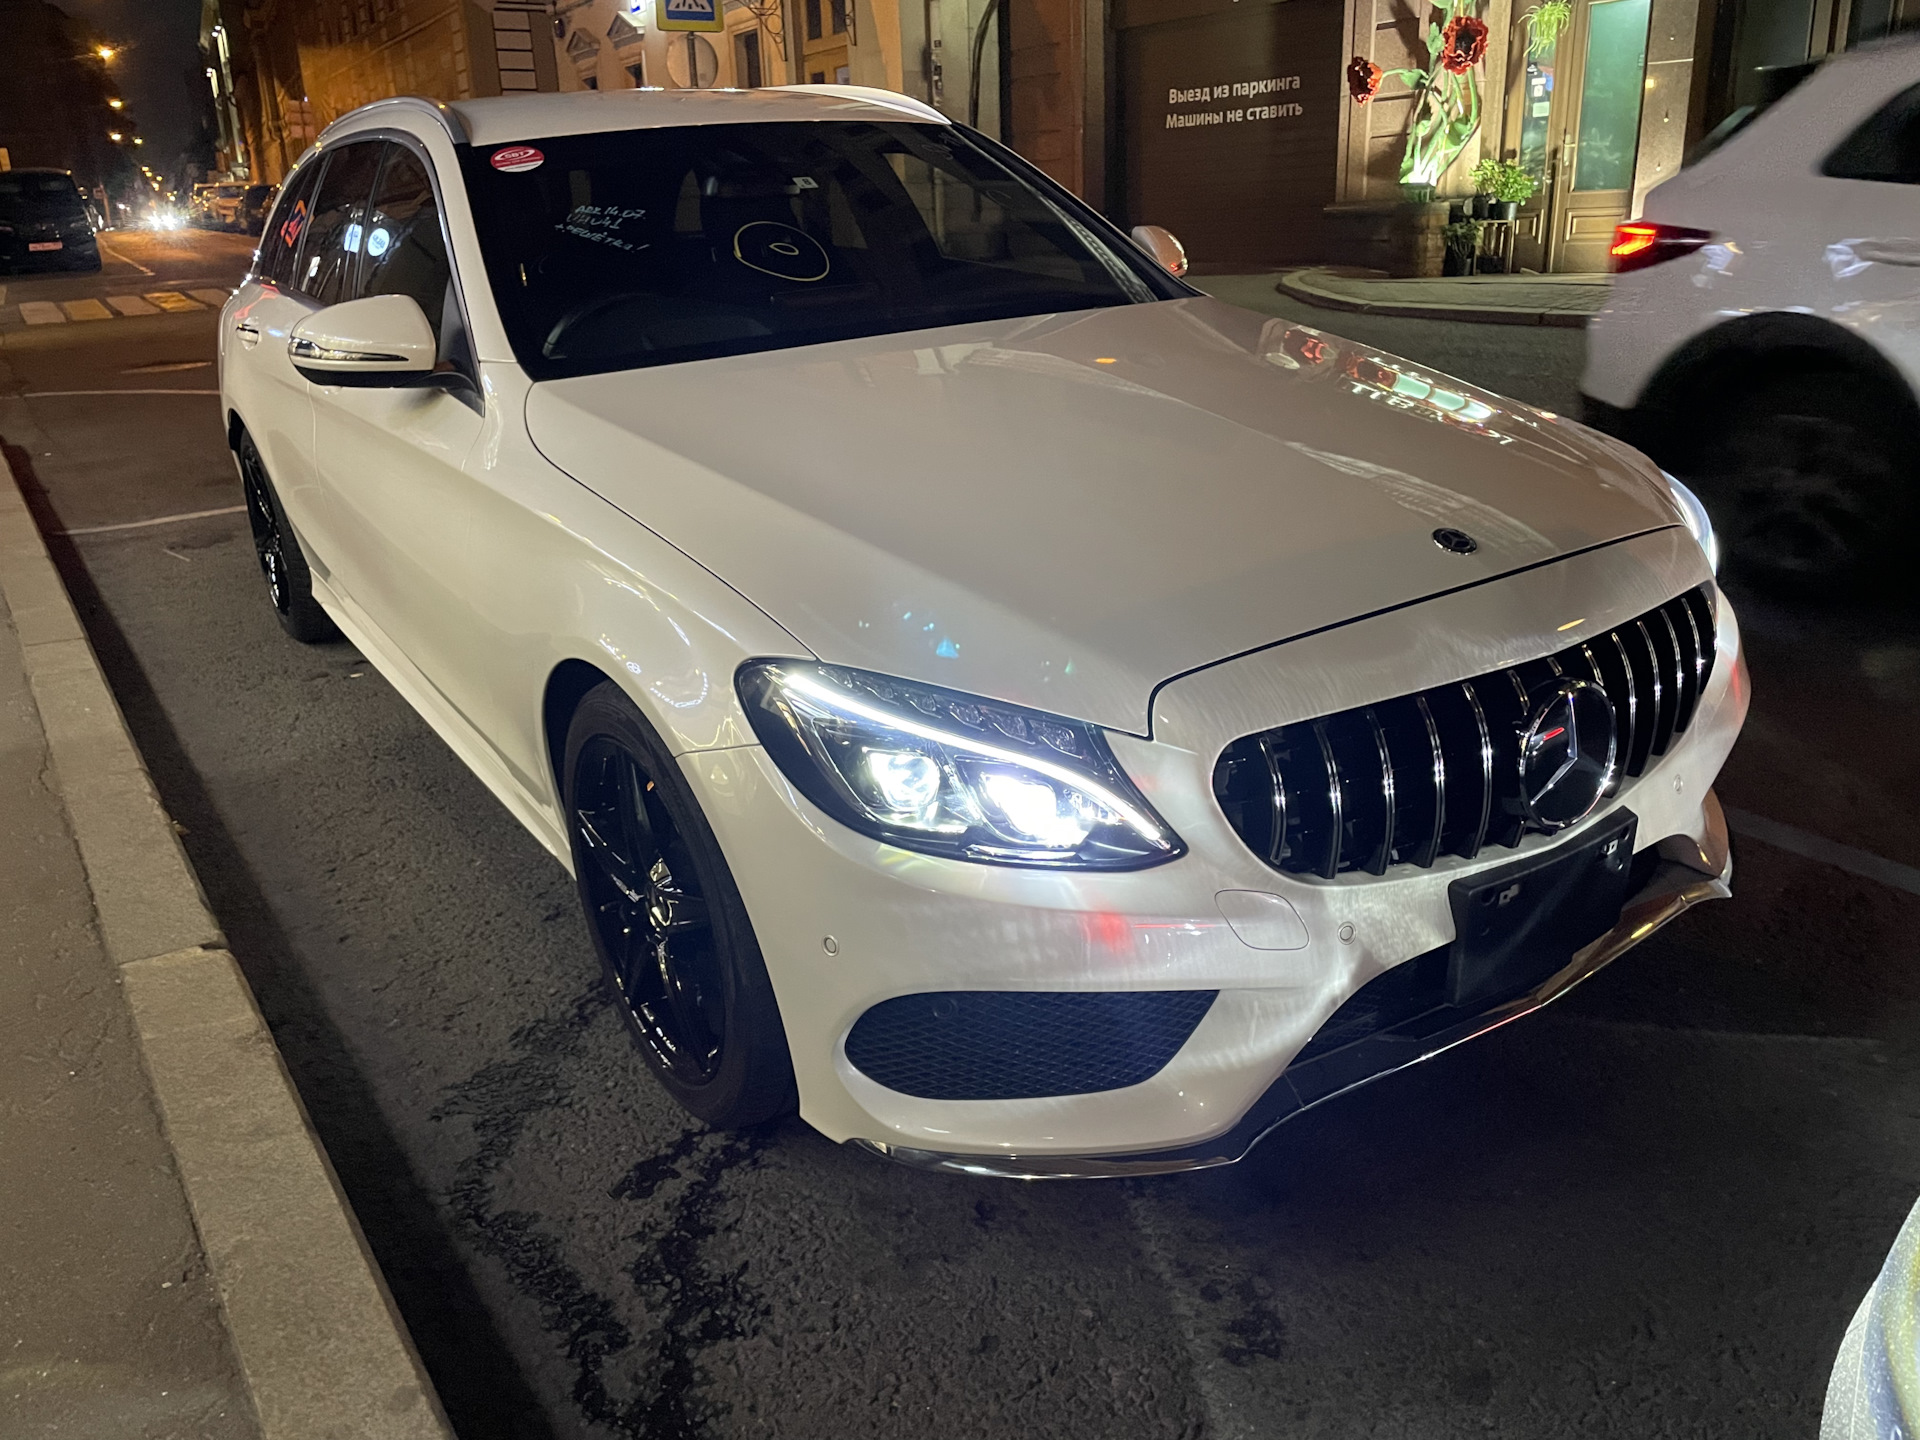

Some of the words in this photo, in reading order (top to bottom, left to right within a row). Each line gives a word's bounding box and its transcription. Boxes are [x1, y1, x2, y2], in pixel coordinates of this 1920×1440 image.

[1168, 87, 1211, 104] Выезд
[1213, 84, 1230, 99] из
[1232, 76, 1301, 98] паркинга
[1165, 112, 1223, 129] Машины
[1226, 108, 1243, 123] не
[1246, 103, 1303, 120] ставить
